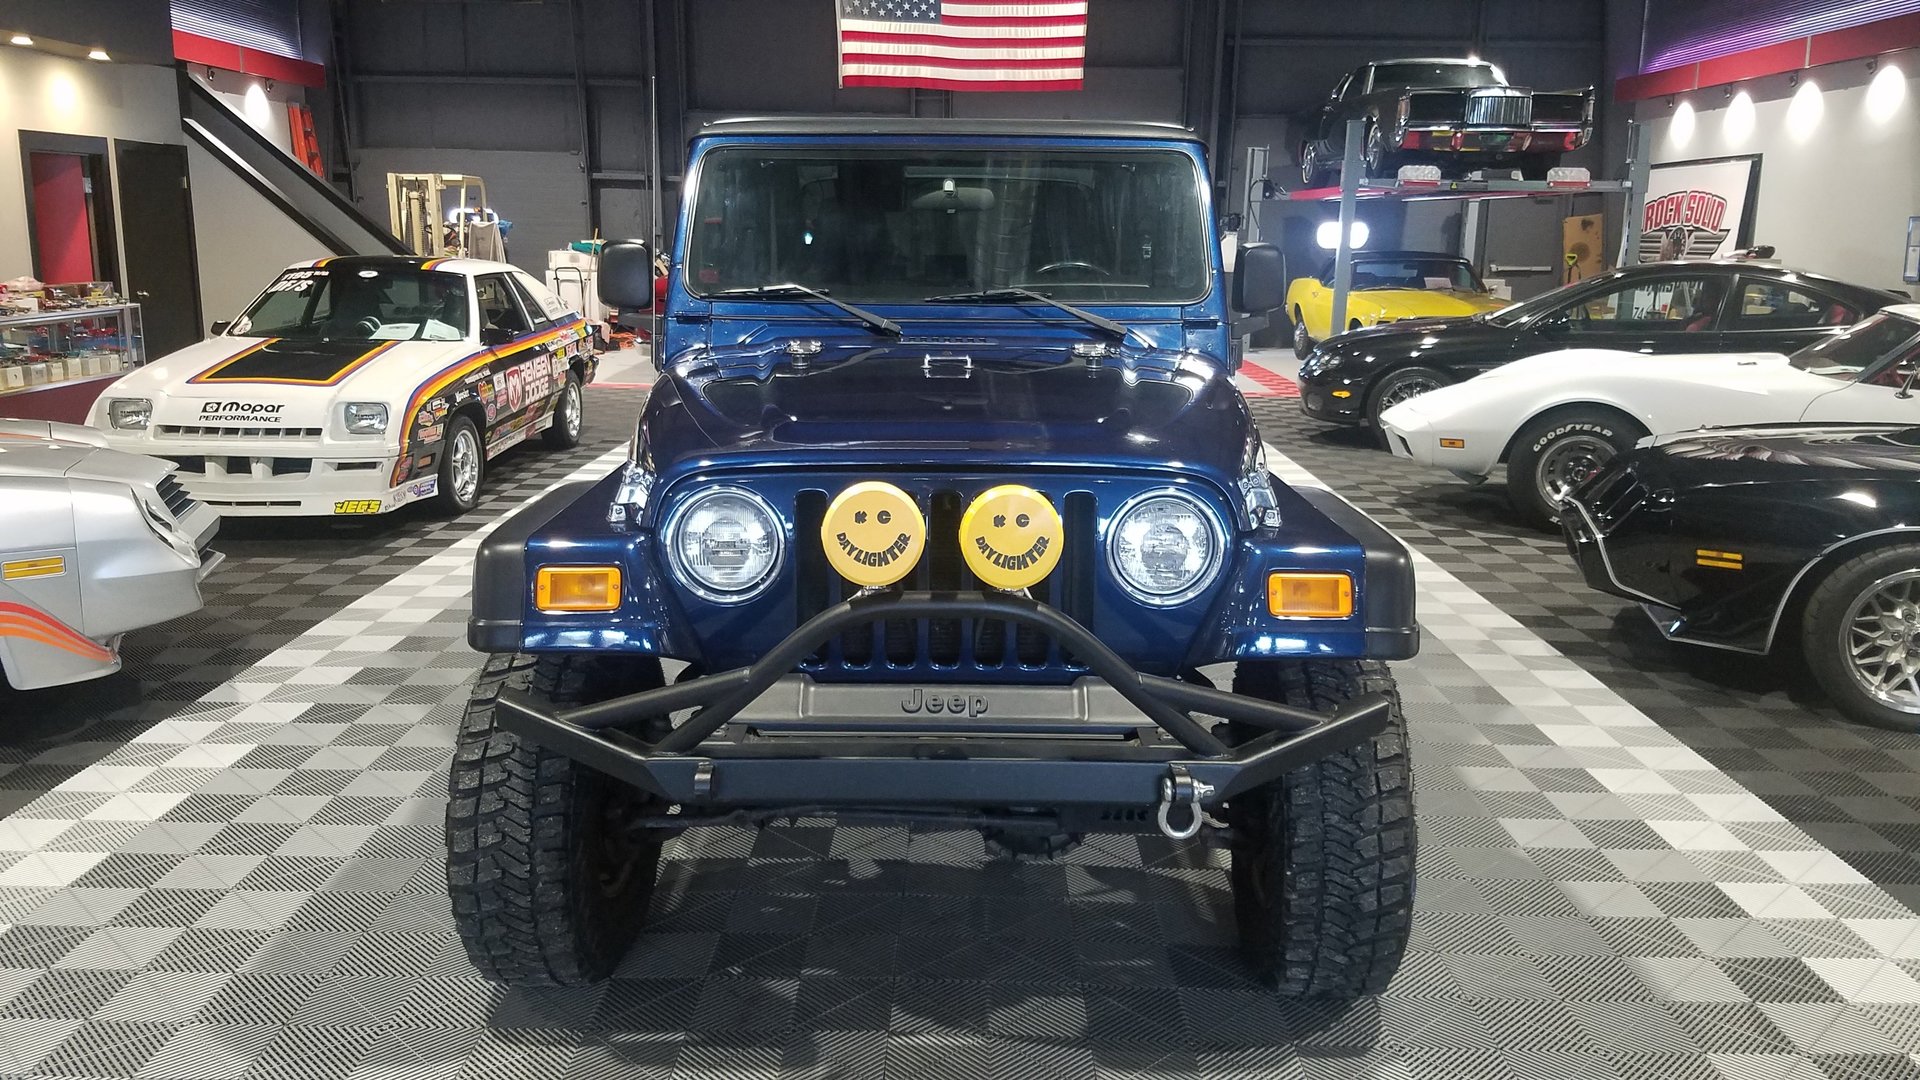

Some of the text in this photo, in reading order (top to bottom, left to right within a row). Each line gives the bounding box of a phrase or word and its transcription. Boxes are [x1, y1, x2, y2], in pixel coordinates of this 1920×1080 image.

[1642, 190, 1727, 235] ROCK SOLID
[525, 375, 549, 405] DODGE
[198, 414, 283, 423] PERFORMANCE
[222, 401, 286, 414] Mopar
[1532, 423, 1613, 452] GOODYEAR
[836, 532, 912, 567] DAYLIGHTER
[975, 536, 1050, 571] DAYLIGHTER
[901, 688, 989, 718] Jeep
